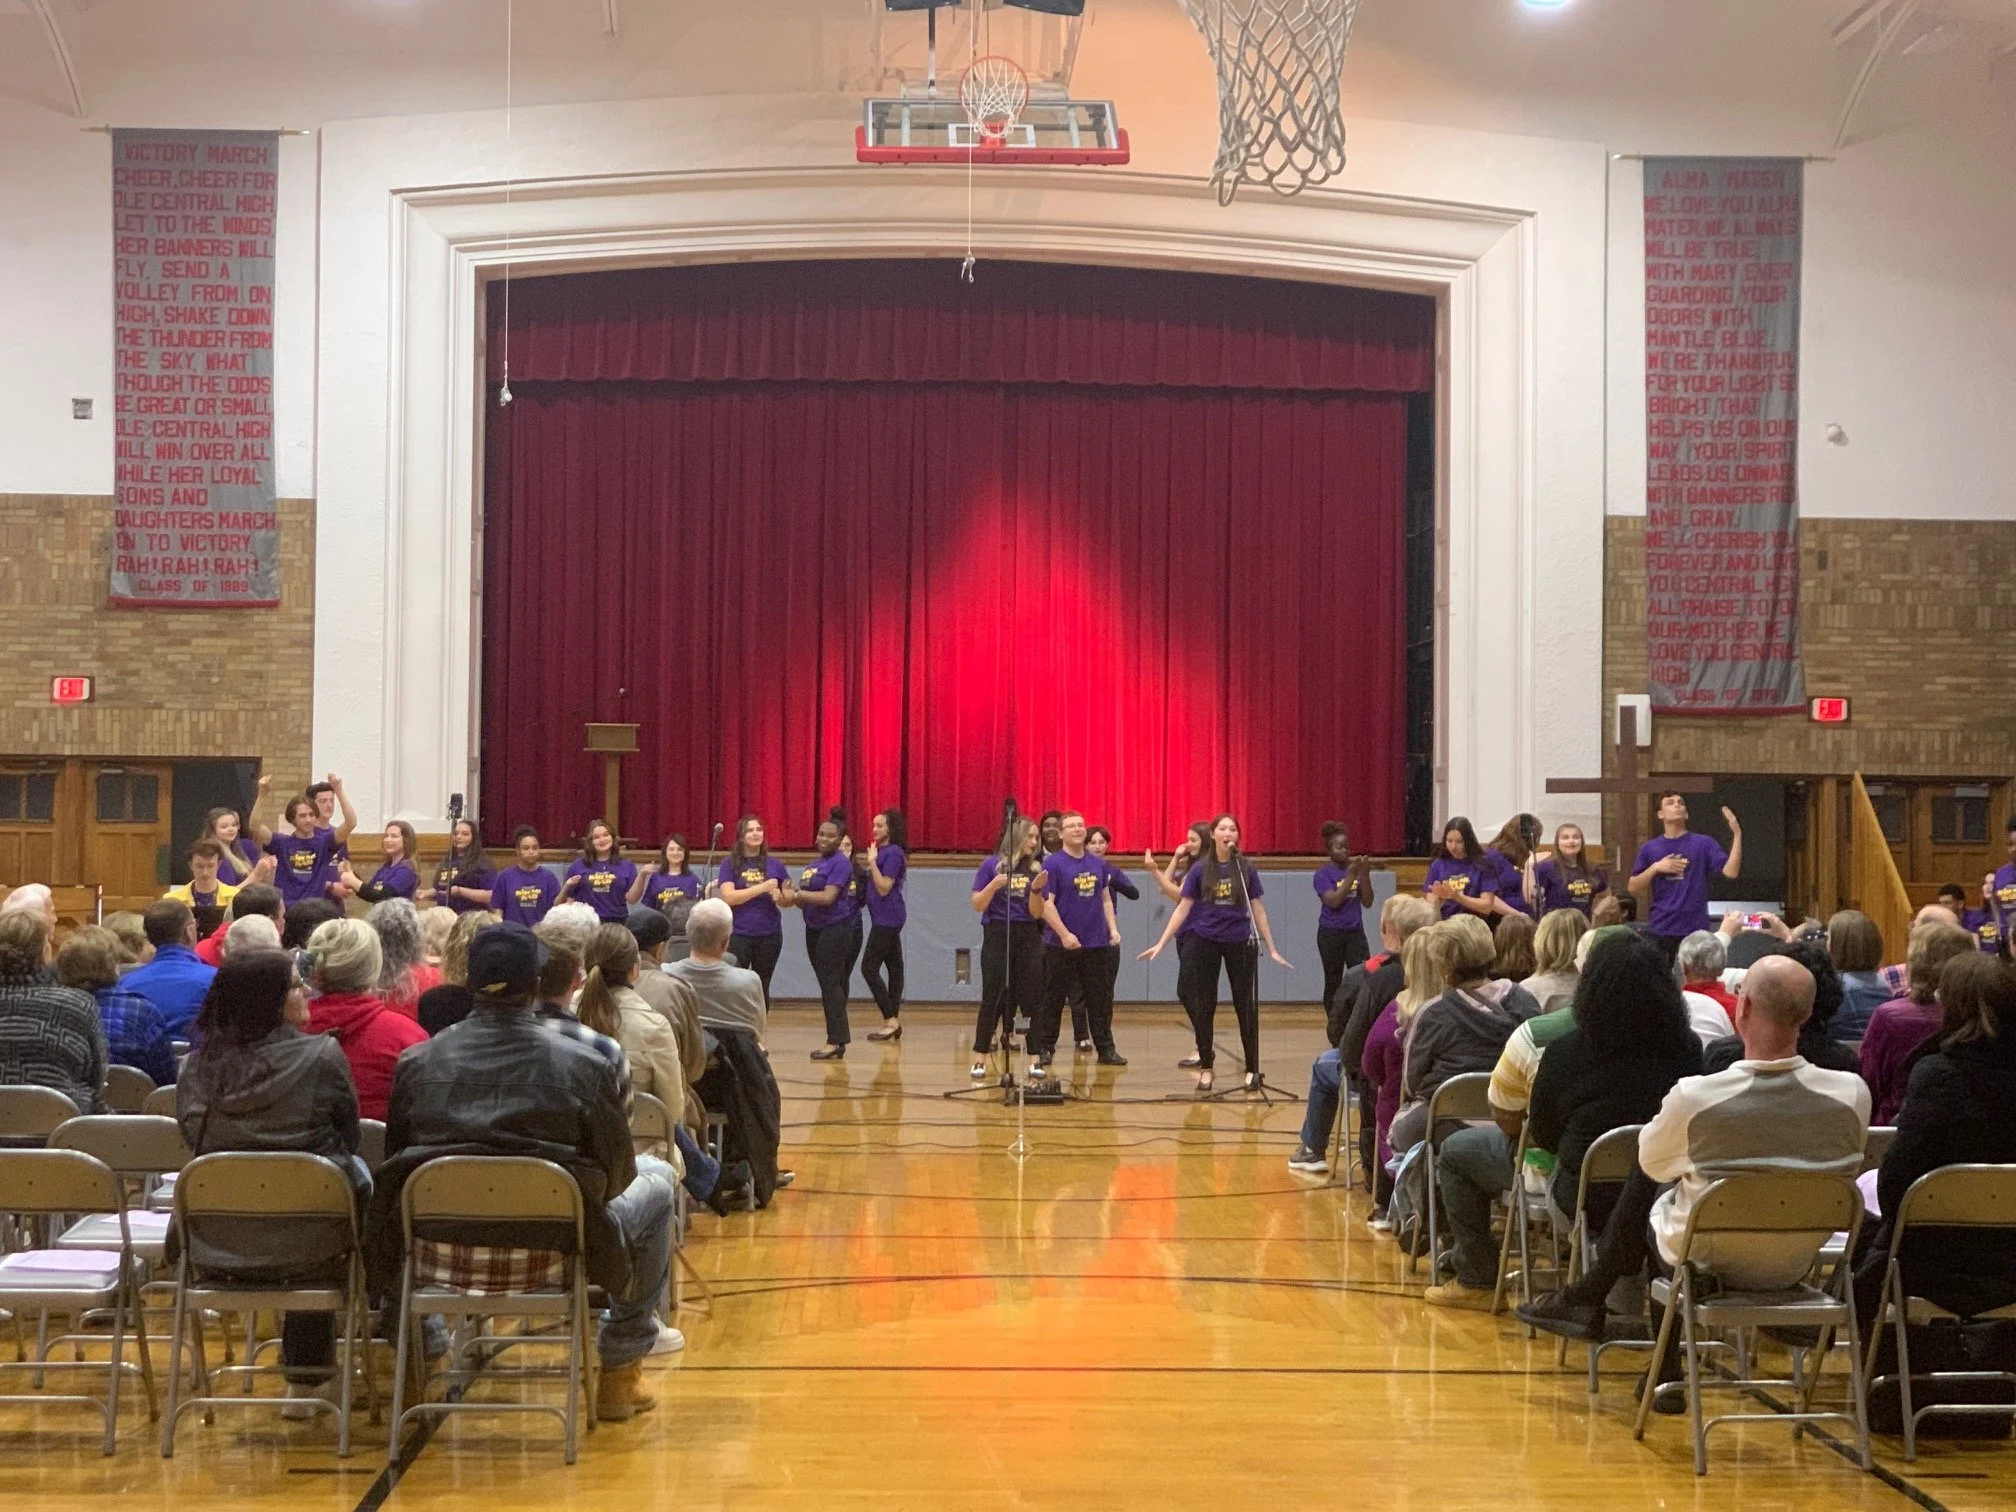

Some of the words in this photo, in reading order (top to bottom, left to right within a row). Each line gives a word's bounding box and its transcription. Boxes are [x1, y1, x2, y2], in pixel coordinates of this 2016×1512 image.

[124, 142, 197, 161] VICTORY
[207, 145, 267, 164] MARCH
[179, 170, 237, 188] CHEER
[242, 172, 277, 190] FOR
[151, 192, 229, 211] CENTRAL
[155, 215, 176, 233] TO
[182, 216, 216, 233] THE
[223, 216, 272, 235] WINDS
[116, 237, 148, 255] HER
[154, 238, 233, 257] BANNERS
[239, 240, 273, 258] WILL
[1685, 240, 1708, 258] BE
[161, 260, 209, 279] SEND
[219, 262, 230, 279] A
[1646, 264, 1684, 280] WITH
[1691, 264, 1736, 280] MARY
[116, 282, 179, 301] VOLLEY
[192, 284, 238, 303] FROM
[249, 286, 271, 304] ON
[1646, 285, 1733, 303] GUARDING
[1742, 285, 1787, 303] YOUR
[164, 306, 220, 324] SHAKE
[227, 308, 271, 325] DOWN
[1646, 307, 1705, 325] DOORS
[1711, 308, 1752, 325] WITH
[116, 327, 145, 346] THE
[151, 329, 225, 347] THUNDER
[230, 331, 273, 349] FROM
[1646, 329, 1714, 347] MANTLE
[116, 349, 148, 369] THE
[206, 353, 249, 372] WHAT
[117, 373, 182, 392] THOUGH
[187, 375, 222, 393] THE
[227, 376, 271, 394] ODDS
[1646, 375, 1677, 391] FOR
[1681, 375, 1725, 392] YOUR
[136, 395, 190, 414] GREAT
[194, 397, 217, 415] OR
[1649, 396, 1708, 414] BRIGHT
[1718, 397, 1759, 415] THAT
[152, 420, 233, 439] CENTRAL
[236, 421, 271, 439] HIGH
[1649, 419, 1704, 437] HELPS
[1711, 420, 1733, 437] US
[1739, 420, 1760, 437] ON
[155, 442, 183, 460] WIN
[190, 443, 235, 460] OVER
[240, 443, 271, 461] ALL
[1691, 442, 1736, 459] YOUR
[168, 465, 203, 484] HER
[211, 466, 261, 484] LOYAL
[1648, 463, 1703, 481] LEADS
[1707, 464, 1729, 482] US
[171, 488, 208, 506] AND
[1647, 486, 1682, 503] WITH
[1687, 486, 1765, 503] BANNERS
[115, 509, 214, 529] DAUGHTERS
[218, 512, 276, 530] MARCH
[1650, 509, 1681, 526] AND
[116, 532, 136, 550] ON
[147, 533, 170, 551] TO
[116, 555, 158, 576] RAH!
[161, 556, 209, 577] RAH!
[214, 557, 259, 577] RAH!
[1647, 552, 1722, 570] FOREVER
[1725, 553, 1760, 571] AND
[138, 579, 182, 592] CLASS
[193, 580, 208, 592] OF
[1685, 575, 1762, 593] CENTRAL
[1648, 599, 1678, 615] ALL
[1681, 599, 1741, 616] PRAISE
[1648, 621, 1682, 638] OUR
[1688, 621, 1759, 639] MOTHER
[1649, 643, 1689, 660] LOVE
[1651, 666, 1690, 684] HIGH
[1676, 688, 1716, 701] CLASS
